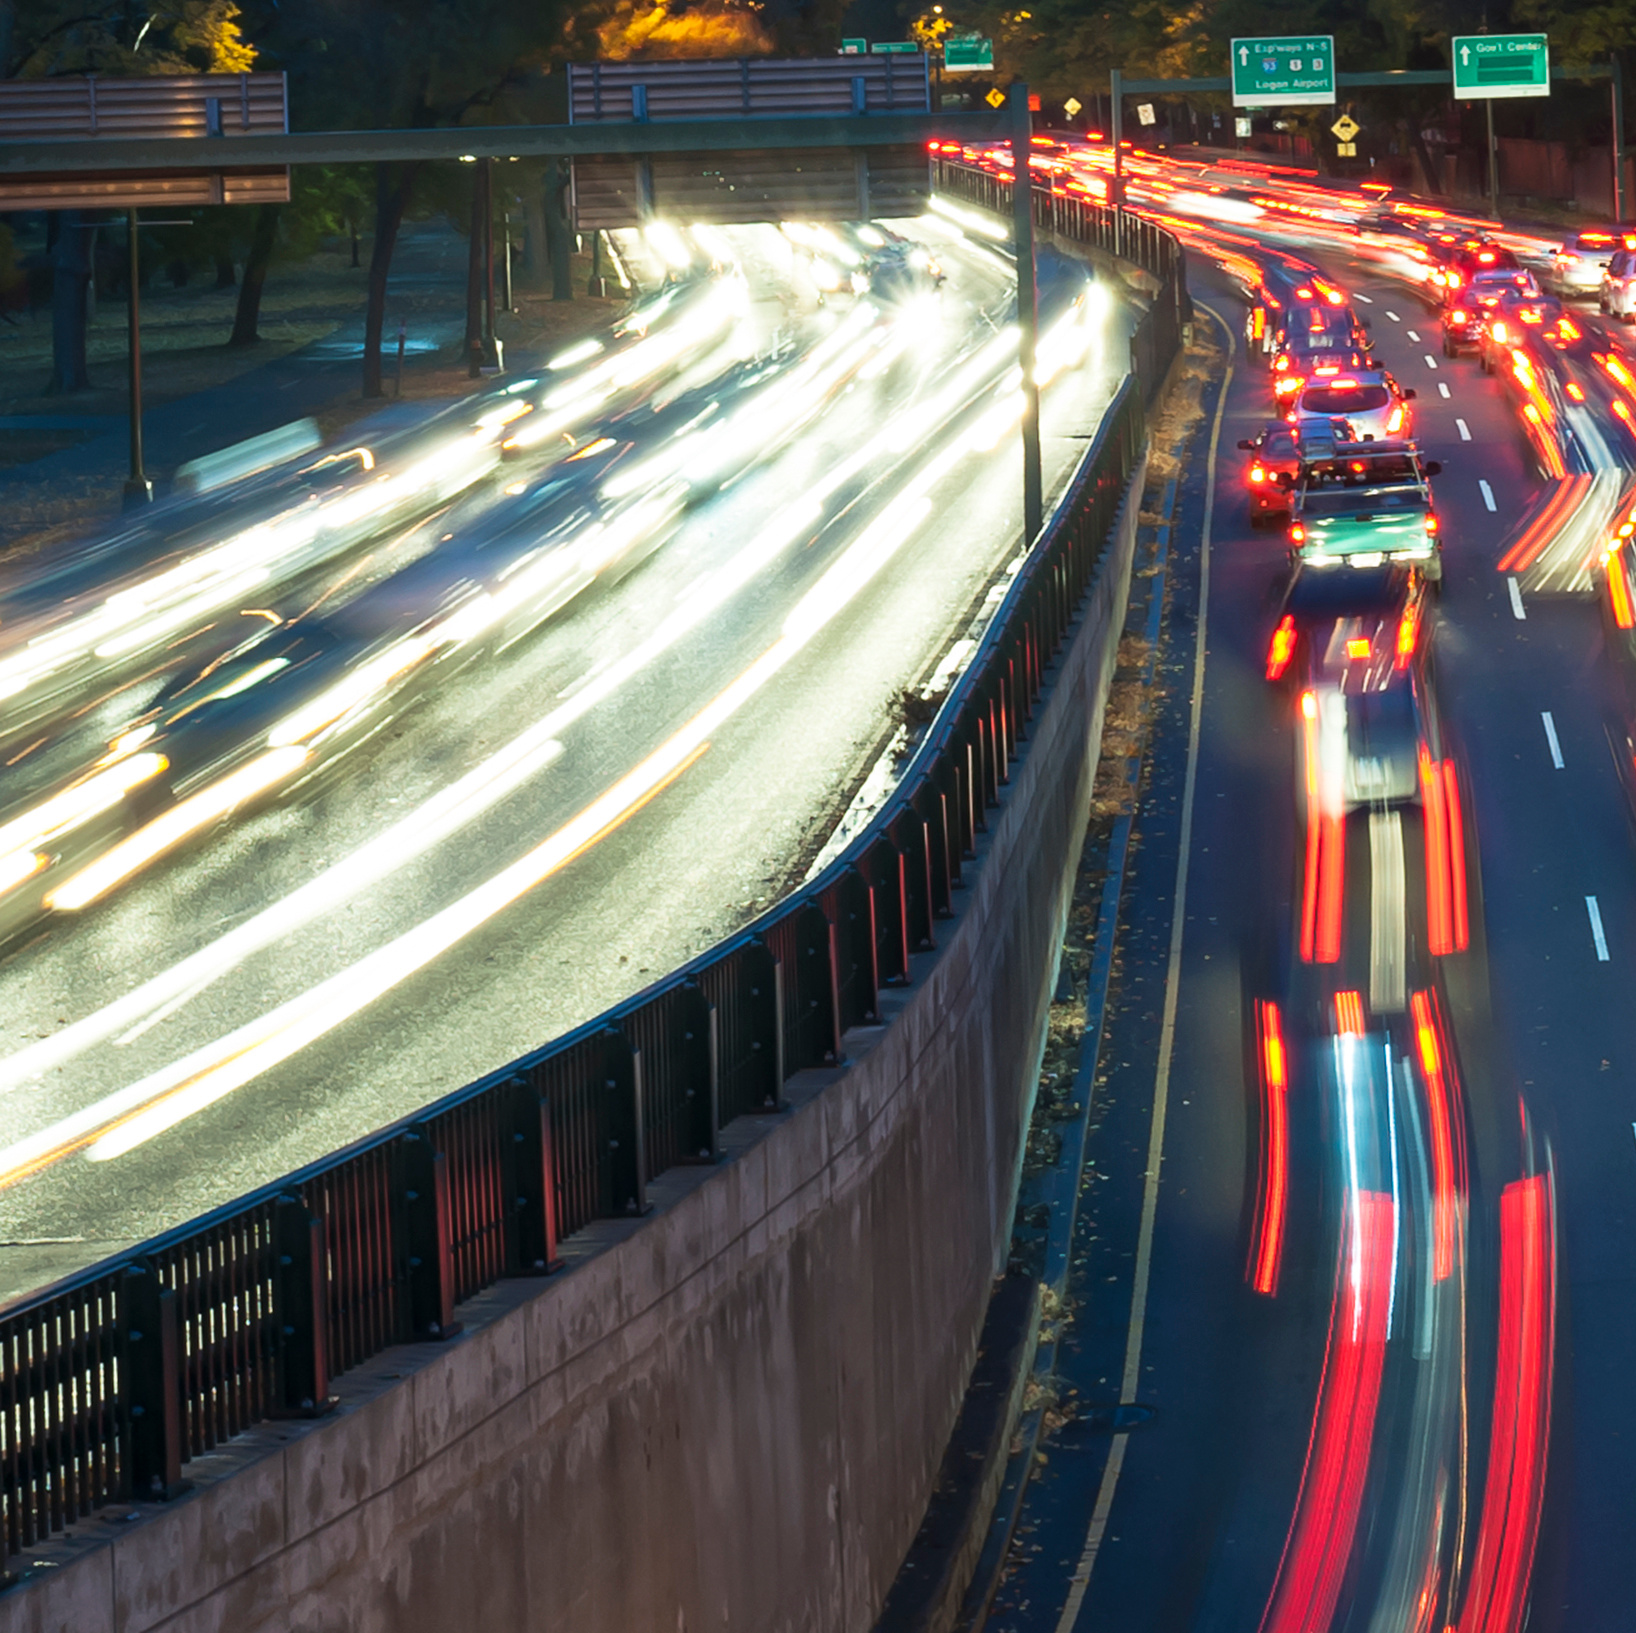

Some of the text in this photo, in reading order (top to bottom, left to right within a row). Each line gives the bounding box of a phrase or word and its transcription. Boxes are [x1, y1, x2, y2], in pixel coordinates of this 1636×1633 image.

[1306, 41, 1328, 52] N-S
[1507, 41, 1543, 52] Center
[1263, 62, 1277, 72] 93
[1255, 78, 1329, 91] Logan Airport
